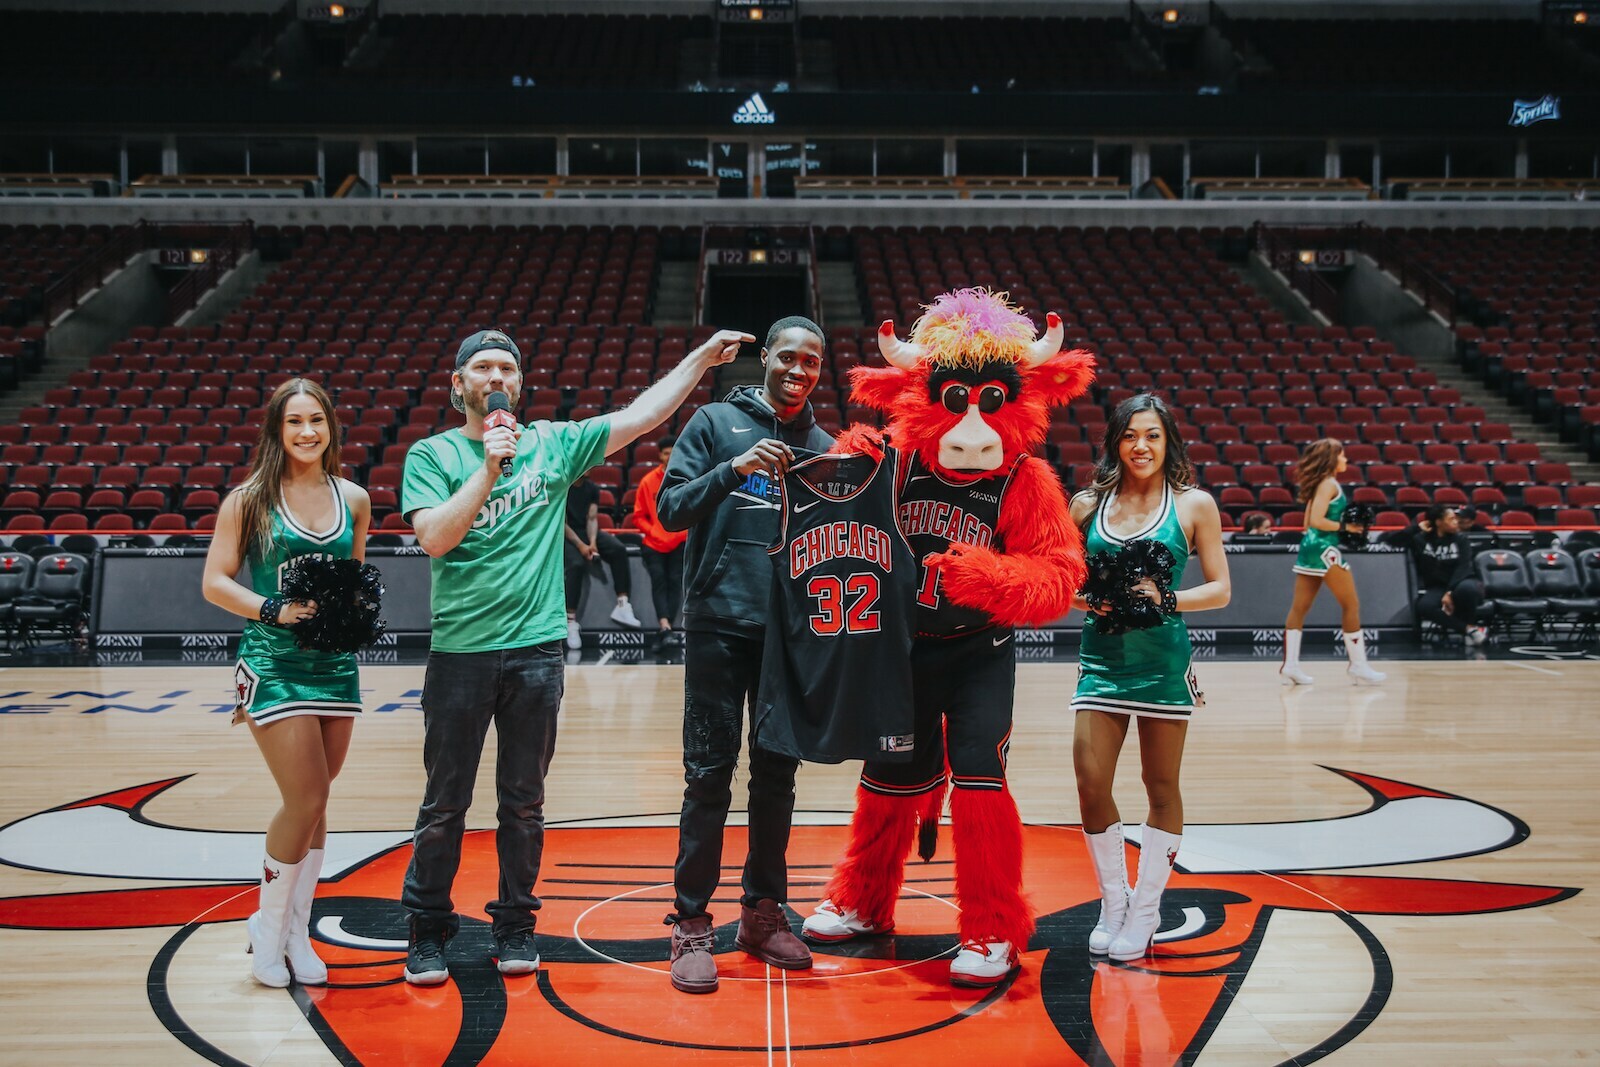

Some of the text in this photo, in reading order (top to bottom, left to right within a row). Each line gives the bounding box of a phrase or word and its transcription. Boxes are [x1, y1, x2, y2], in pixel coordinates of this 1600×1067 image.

[732, 111, 775, 124] adidas
[1513, 99, 1554, 126] Sprite
[166, 250, 185, 263] 121
[723, 250, 743, 264] 122
[772, 250, 792, 264] 101
[1318, 250, 1341, 264] 102
[789, 520, 893, 580] CHICAGO
[807, 571, 882, 637] 32
[96, 635, 143, 647] ZENNI
[181, 635, 228, 647] ZENNI
[598, 633, 645, 644] ZENNI
